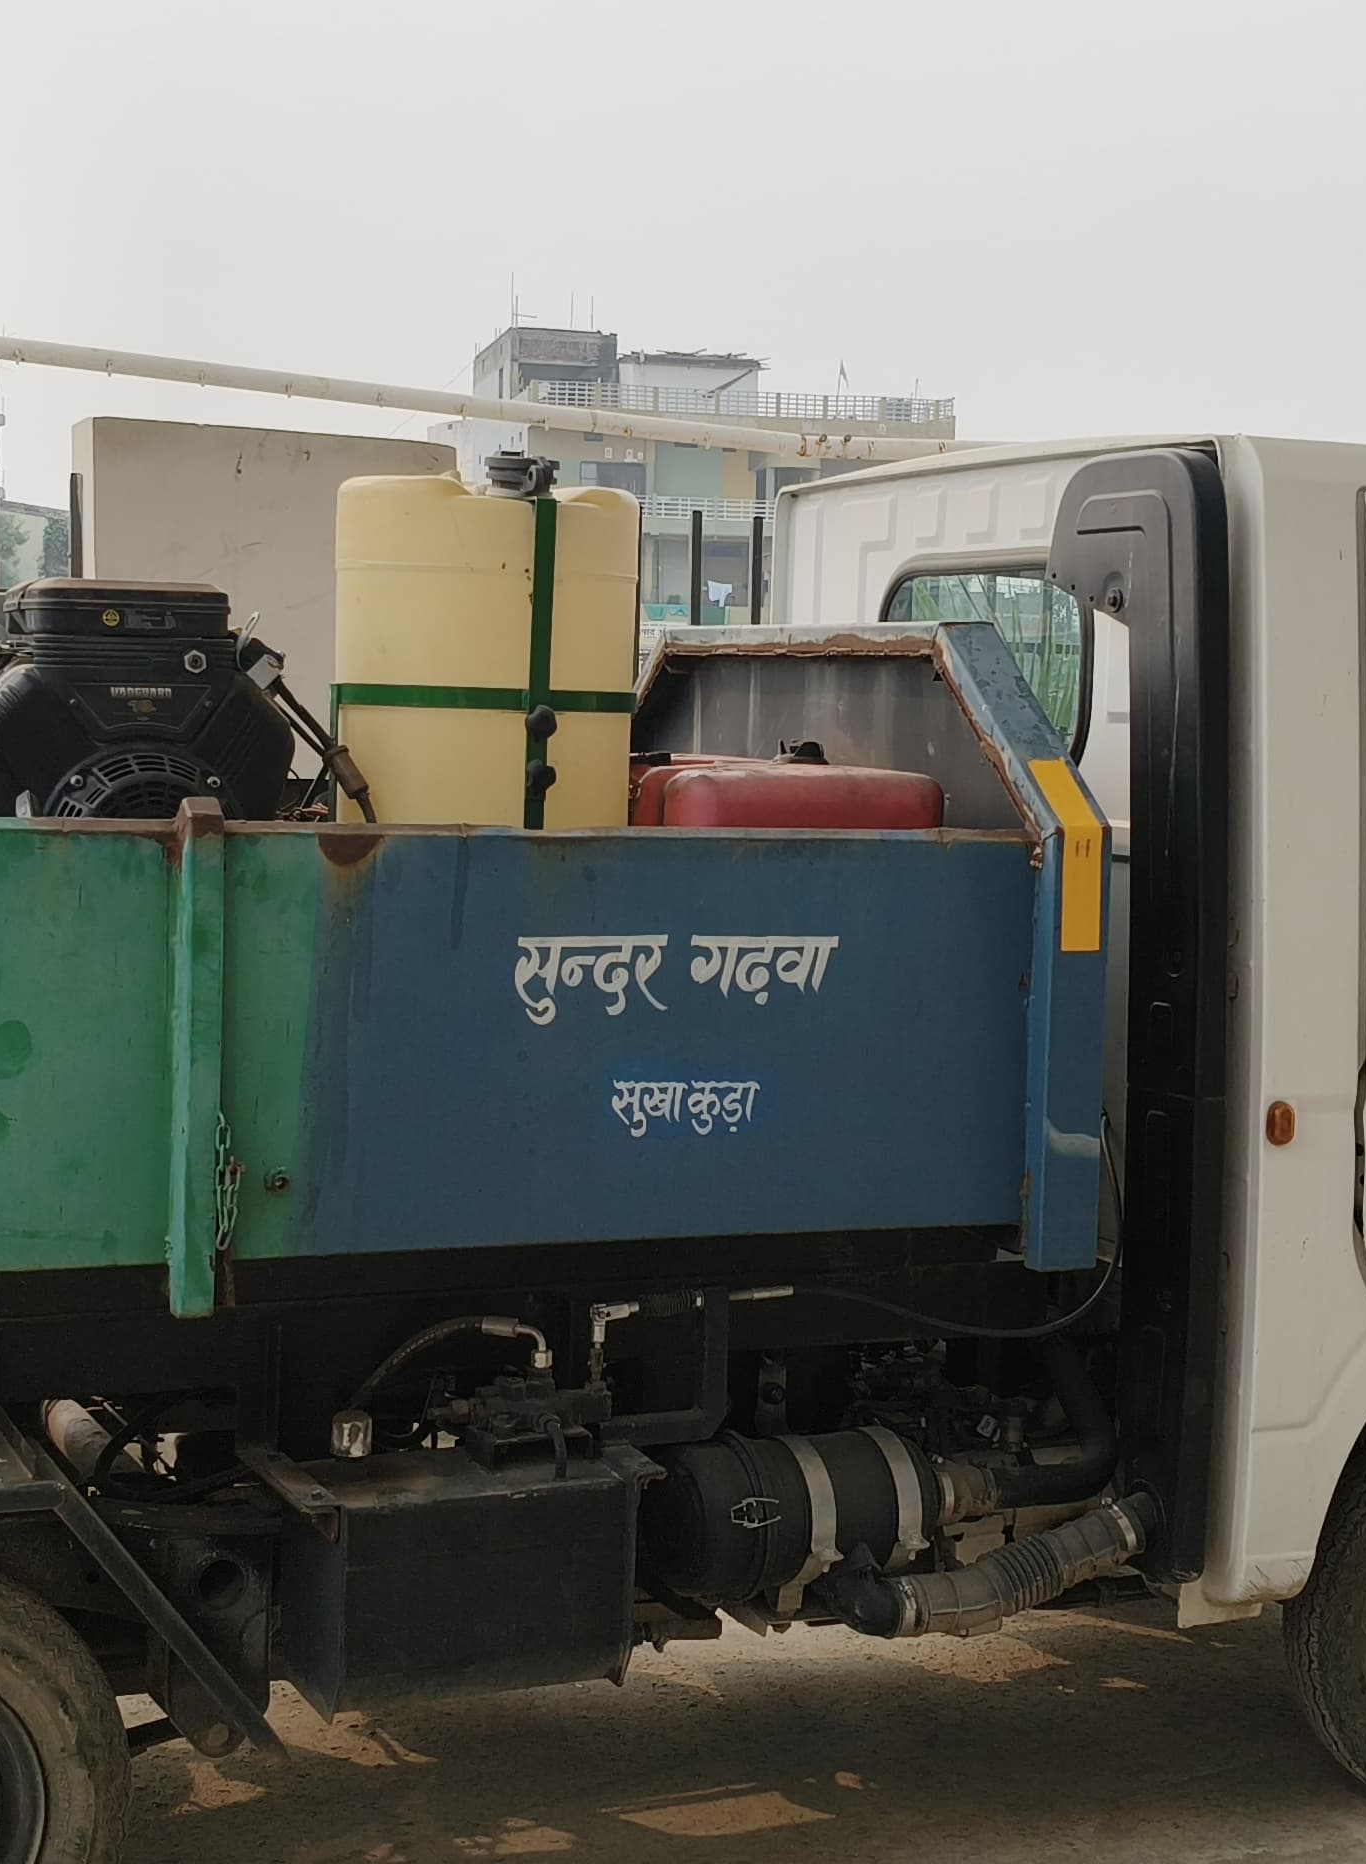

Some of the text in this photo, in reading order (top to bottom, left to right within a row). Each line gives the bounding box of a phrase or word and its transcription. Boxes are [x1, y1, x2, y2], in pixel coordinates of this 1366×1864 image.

[110, 686, 172, 698] VANGUARD
[515, 934, 840, 1025] सुन्दर गढ़वा
[687, 1079, 761, 1135] कुड़ा
